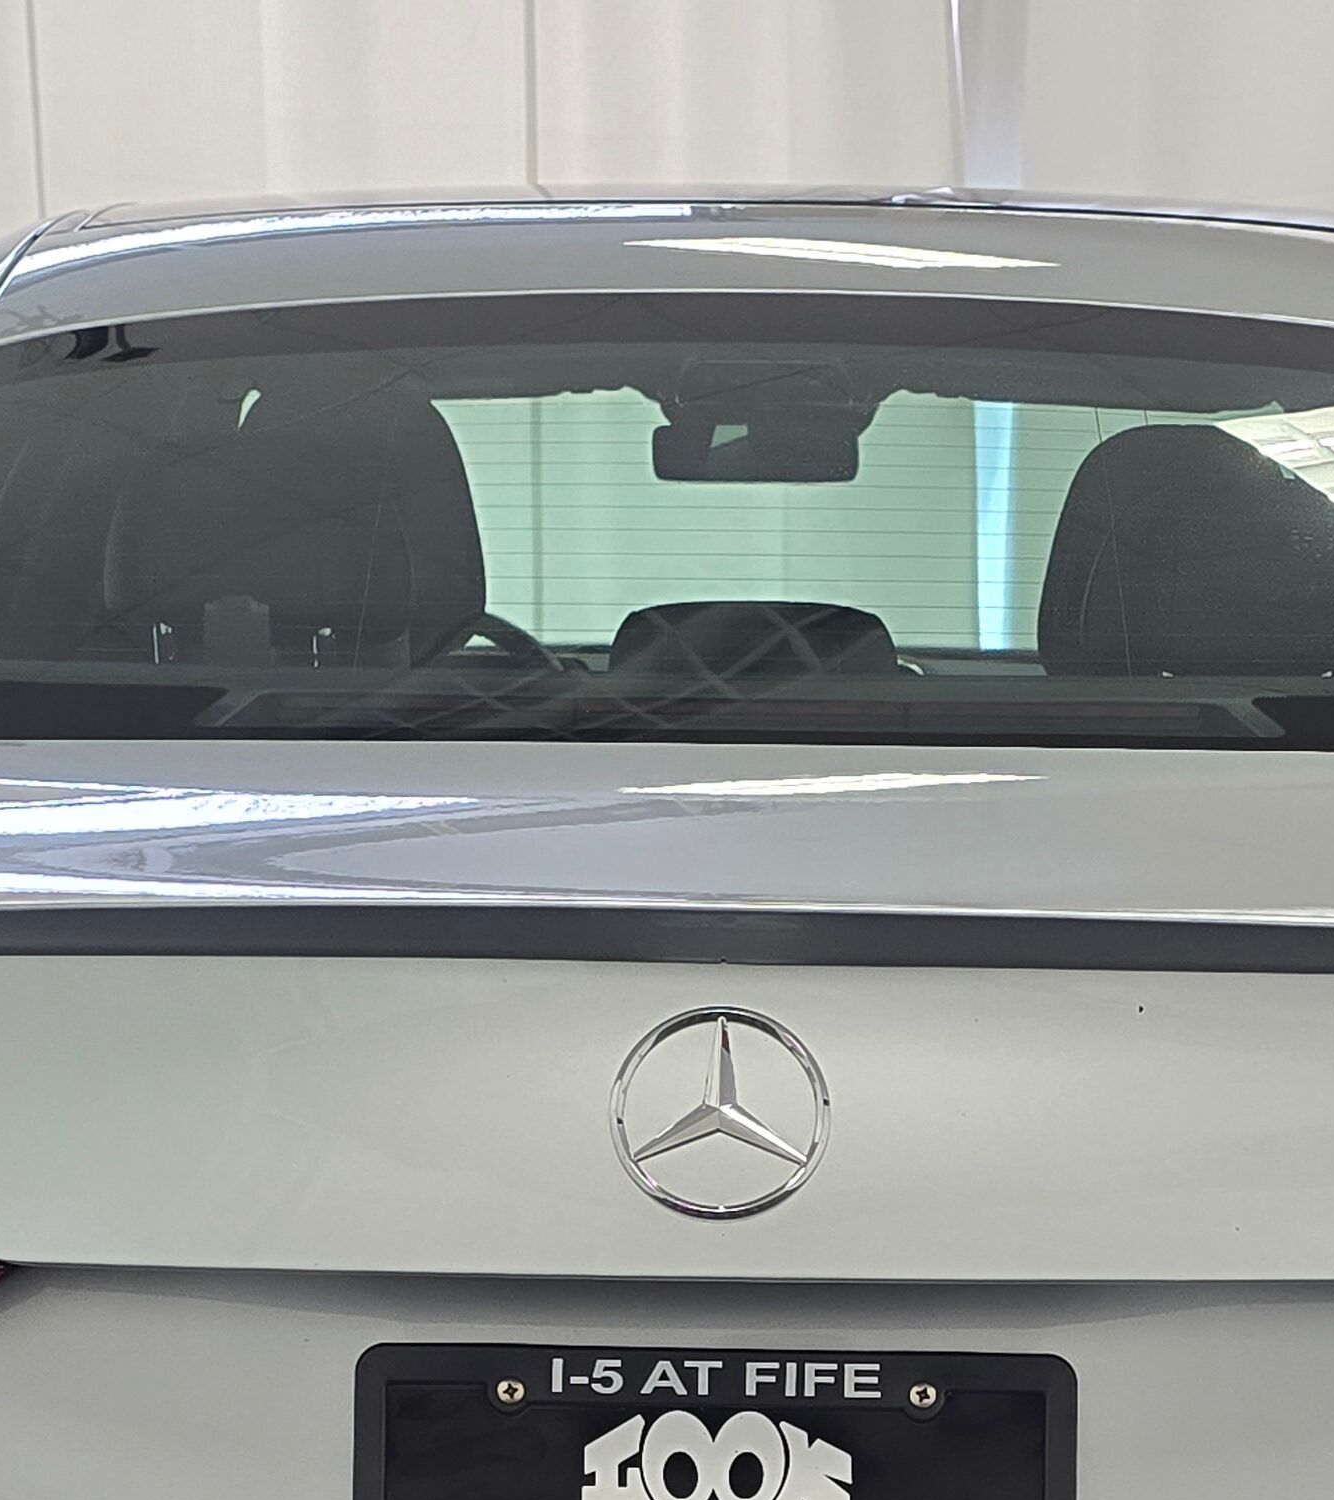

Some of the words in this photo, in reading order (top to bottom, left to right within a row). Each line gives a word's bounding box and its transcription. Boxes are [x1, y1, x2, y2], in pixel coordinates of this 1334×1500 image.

[551, 1358, 624, 1394] I-5
[640, 1360, 723, 1396] AT
[745, 1362, 882, 1399] FIFE
